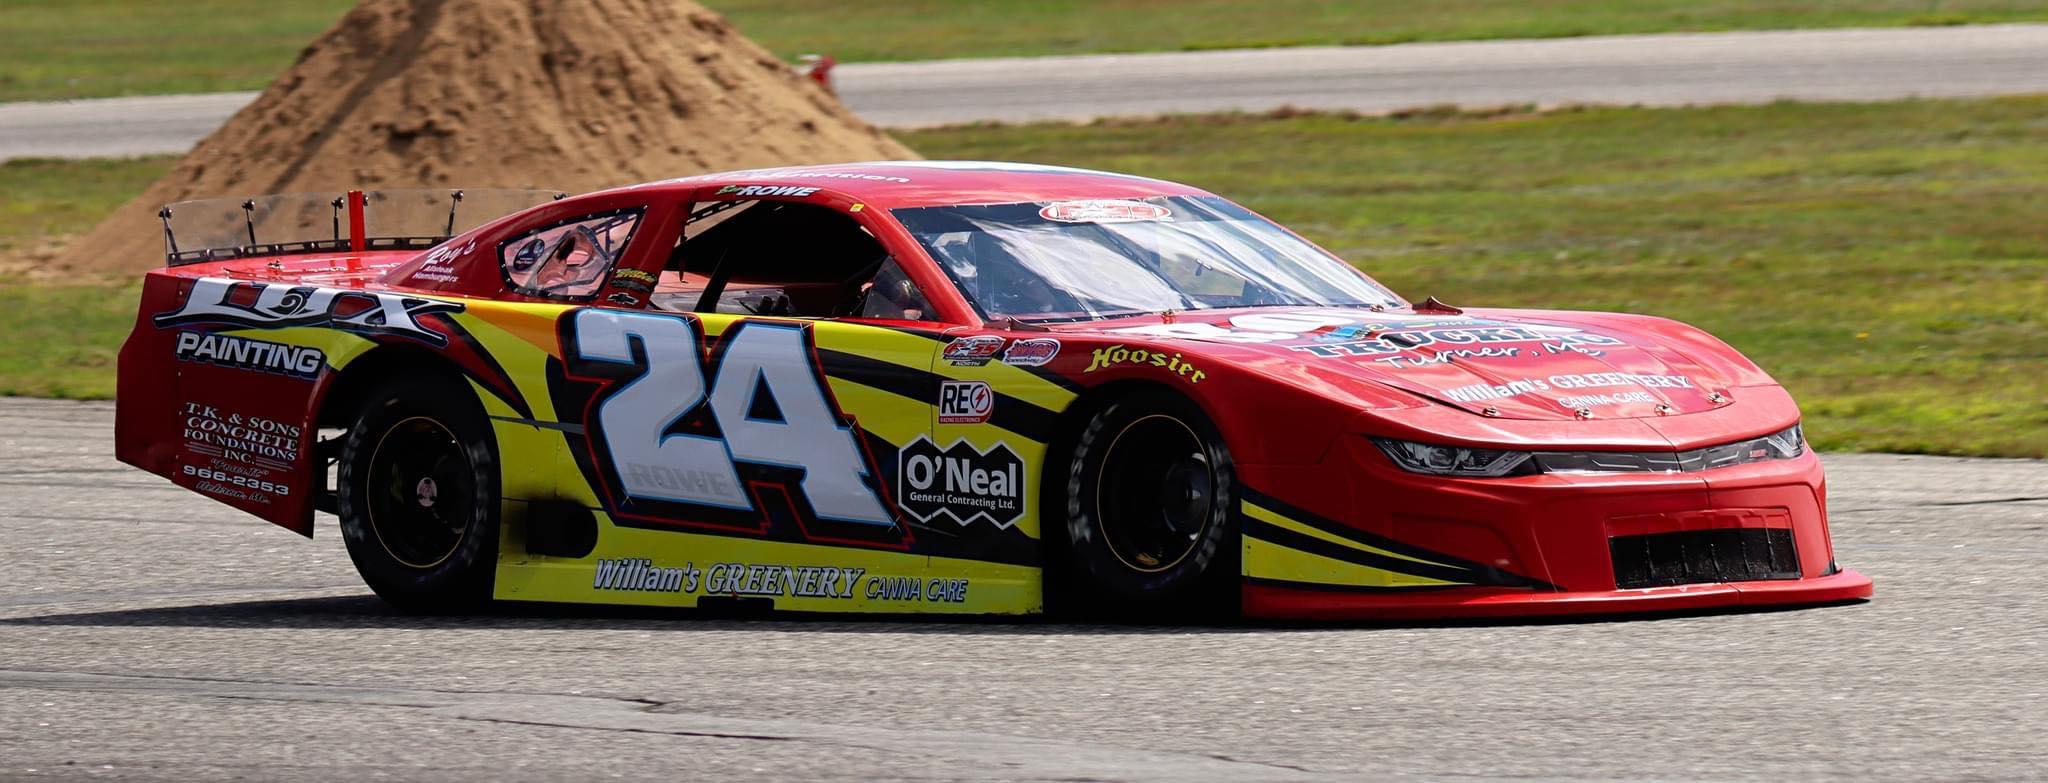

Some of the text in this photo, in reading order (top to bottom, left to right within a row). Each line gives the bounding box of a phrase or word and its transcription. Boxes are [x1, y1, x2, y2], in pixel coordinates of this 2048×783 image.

[736, 185, 822, 197] ROWE
[420, 237, 476, 270] Roy's
[177, 331, 323, 376] PAINTING
[1083, 344, 1206, 384] Hoosier
[1440, 371, 1696, 404] William's GREENERY
[1557, 390, 1655, 410] CANNA CARE
[185, 402, 301, 438] T.K. & SONS
[187, 416, 298, 452] CONCRETE
[574, 307, 900, 528] 24
[184, 428, 297, 462] FOUNDATIONS
[223, 449, 256, 465] INC.
[183, 465, 289, 496] 966-2353
[623, 463, 732, 498] ROWE
[906, 454, 1017, 498] O'Neal
[910, 491, 1016, 511] General Contracting Ltd.
[593, 558, 968, 602] William's GREENERY CANNA CARE
